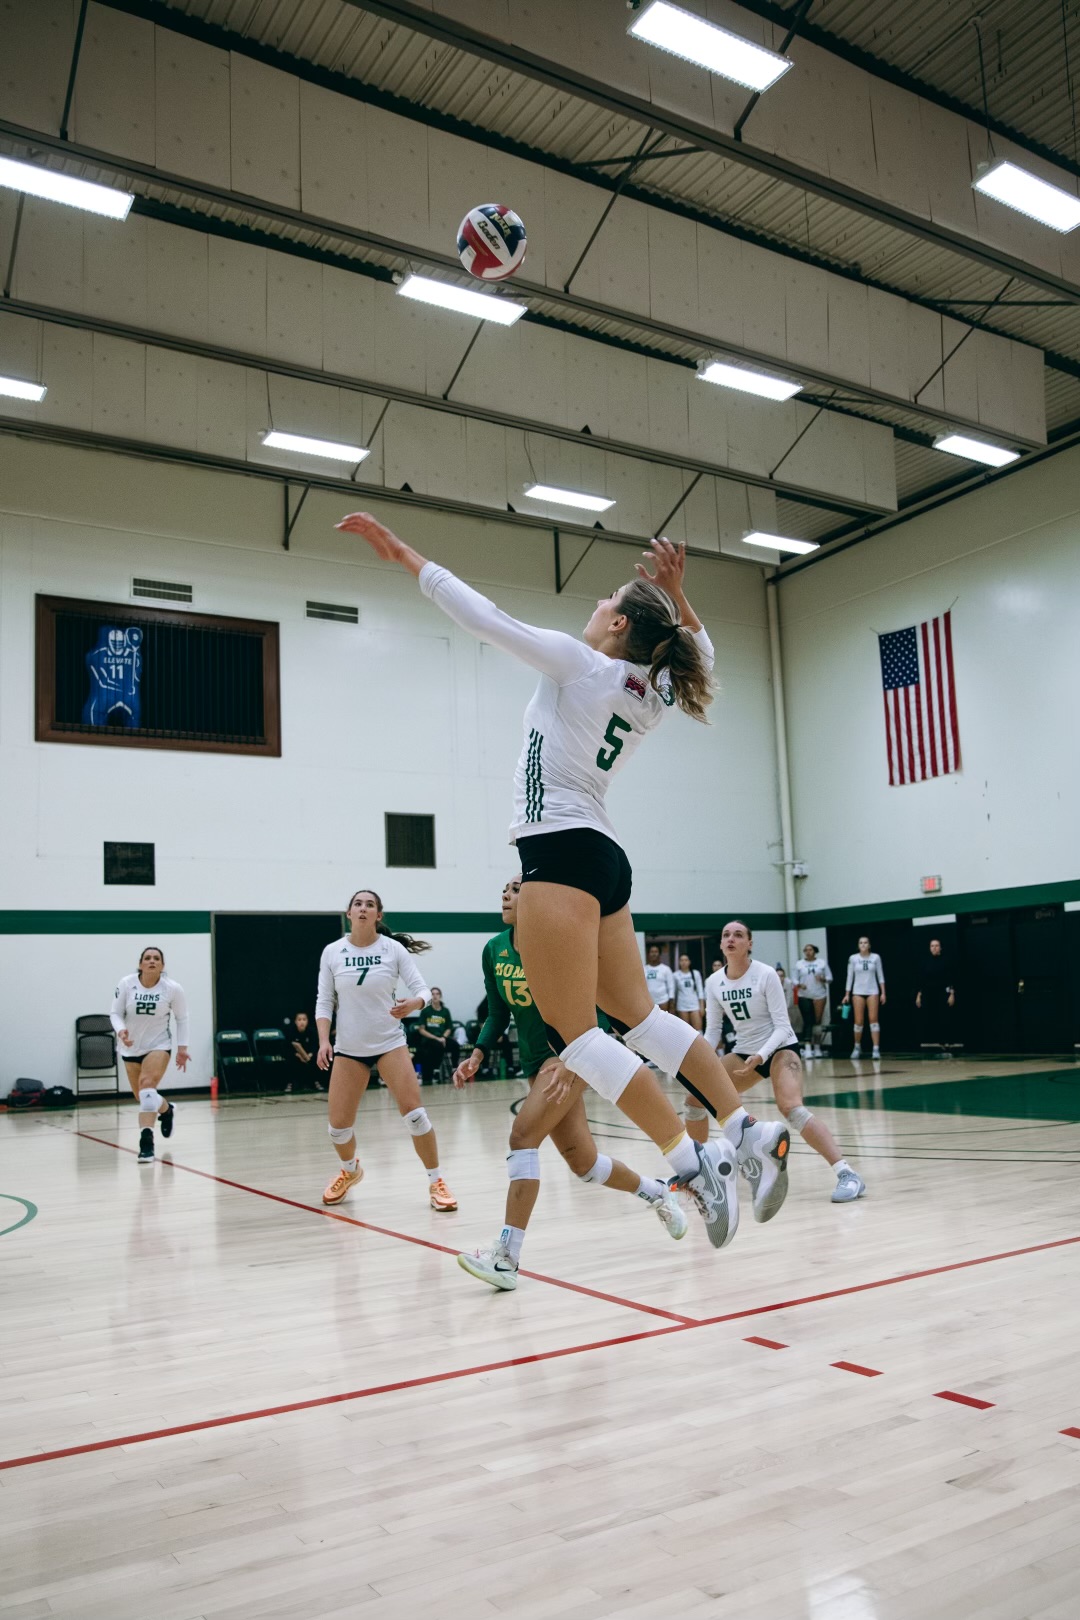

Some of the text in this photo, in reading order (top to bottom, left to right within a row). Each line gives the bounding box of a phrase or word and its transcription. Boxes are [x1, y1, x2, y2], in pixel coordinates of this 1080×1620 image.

[477, 220, 501, 250] Baden
[103, 656, 132, 665] ELEVATE
[109, 664, 124, 679] 11
[596, 712, 632, 771] 5
[345, 955, 382, 967] LIONS
[356, 967, 370, 986] 7
[134, 993, 160, 1001] LIONS
[502, 979, 533, 1007] 13
[722, 987, 752, 1001] LIONS
[135, 1001, 157, 1016] 22
[729, 1000, 751, 1021] 21
